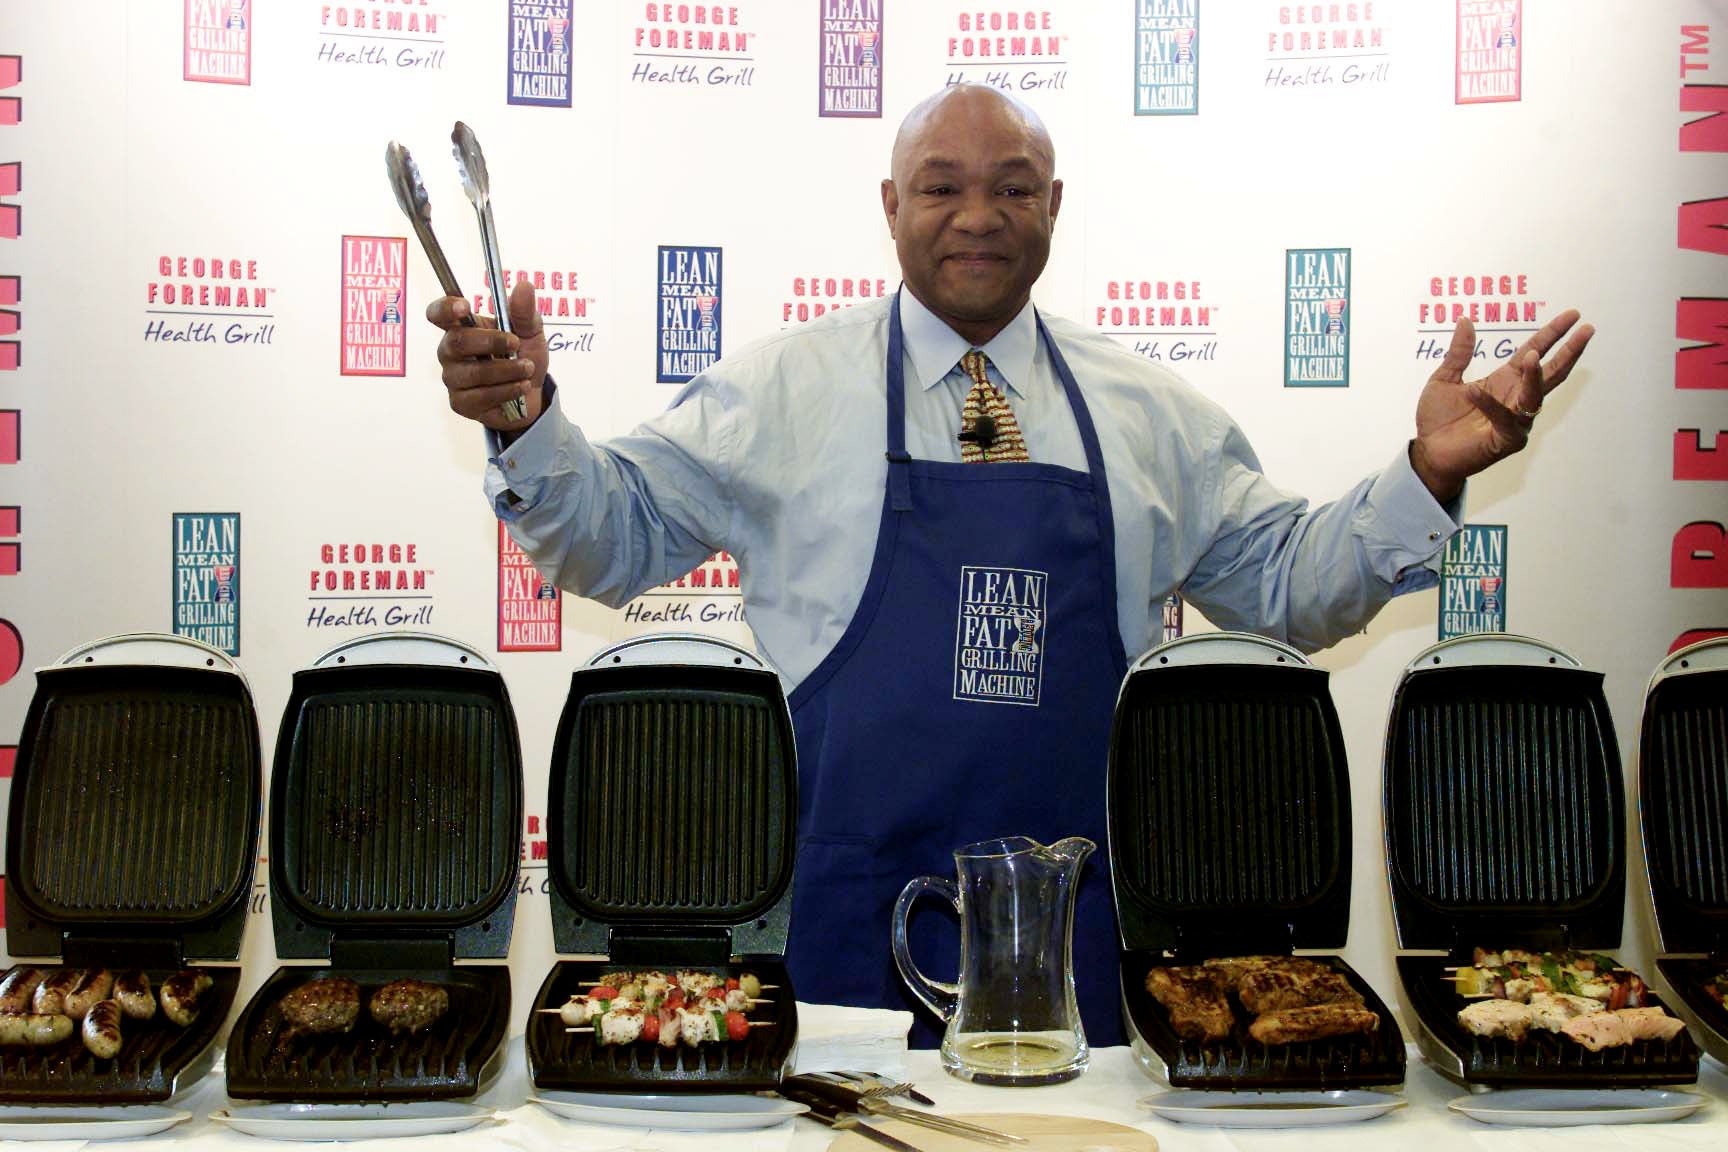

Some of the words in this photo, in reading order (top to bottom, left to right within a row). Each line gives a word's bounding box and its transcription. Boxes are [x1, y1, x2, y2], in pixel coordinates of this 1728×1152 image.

[512, 5, 568, 19] MEAN
[645, 3, 738, 26] GEORGE
[959, 12, 1052, 31] GEORGE
[1139, 17, 1196, 30] MEAN
[1280, 2, 1372, 25] GEORGE
[512, 18, 549, 52] FAT
[823, 21, 879, 32] MEAN
[1460, 15, 1497, 52] FAT
[189, 28, 247, 53] GRILLING
[824, 33, 859, 66] FAT
[1139, 30, 1175, 65] FAT
[189, 50, 247, 79] MACHINE
[318, 43, 388, 65] Health
[396, 48, 445, 69] Grill
[513, 52, 568, 75] GRILLING
[1460, 49, 1517, 73] GRILLING
[512, 74, 568, 99] MACHINE
[632, 63, 700, 84] Health
[707, 66, 755, 86] Grill
[824, 67, 879, 88] GRILLING
[1019, 71, 1068, 90] Grill
[1140, 64, 1195, 86] GRILLING
[1264, 65, 1334, 87] Health
[1342, 62, 1391, 84] Grill
[1460, 71, 1517, 98] MACHINE
[824, 88, 878, 112] MACHINE
[1139, 86, 1195, 110] MACHINE
[159, 256, 257, 280] GEORGE
[346, 240, 403, 276] LEAN
[662, 250, 719, 285] LEAN
[346, 275, 402, 289] MEAN
[1289, 253, 1347, 288] LEAN
[661, 285, 718, 297] MEAN
[793, 277, 886, 298] GEORGE
[1107, 281, 1201, 300] GEORGE
[1289, 287, 1346, 300] MEAN
[1430, 275, 1527, 297] GEORGE
[346, 288, 381, 323] FAT
[661, 297, 698, 331] FAT
[1289, 300, 1325, 335] FAT
[144, 321, 217, 343] Health
[224, 323, 275, 344] Grill
[346, 322, 402, 345] GRILLING
[547, 332, 595, 352] Grill
[662, 330, 717, 351] GRILLING
[346, 344, 402, 371] MACHINE
[1169, 341, 1218, 361] Grill
[1289, 335, 1345, 357] GRILLING
[1289, 356, 1345, 381] MACHINE
[177, 518, 236, 553] LEAN
[1445, 529, 1503, 564] LEAN
[178, 553, 235, 566] MEAN
[321, 543, 417, 564] GEORGE
[1444, 564, 1502, 577] MEAN
[178, 567, 215, 603] FAT
[503, 567, 538, 600] FAT
[964, 571, 1044, 608] LEAN
[1444, 577, 1481, 612] FAT
[178, 602, 235, 626] GRILLING
[307, 606, 377, 628] Health
[384, 605, 434, 626] Grill
[503, 600, 557, 622] GRILLING
[624, 602, 693, 623] Health
[962, 604, 1041, 619] MEAN
[1444, 612, 1501, 634] GRILLING
[503, 622, 557, 646] MACHINE
[962, 615, 1012, 650] FAT
[961, 648, 1037, 673] GRILLING
[959, 669, 1037, 698] MACHINE
